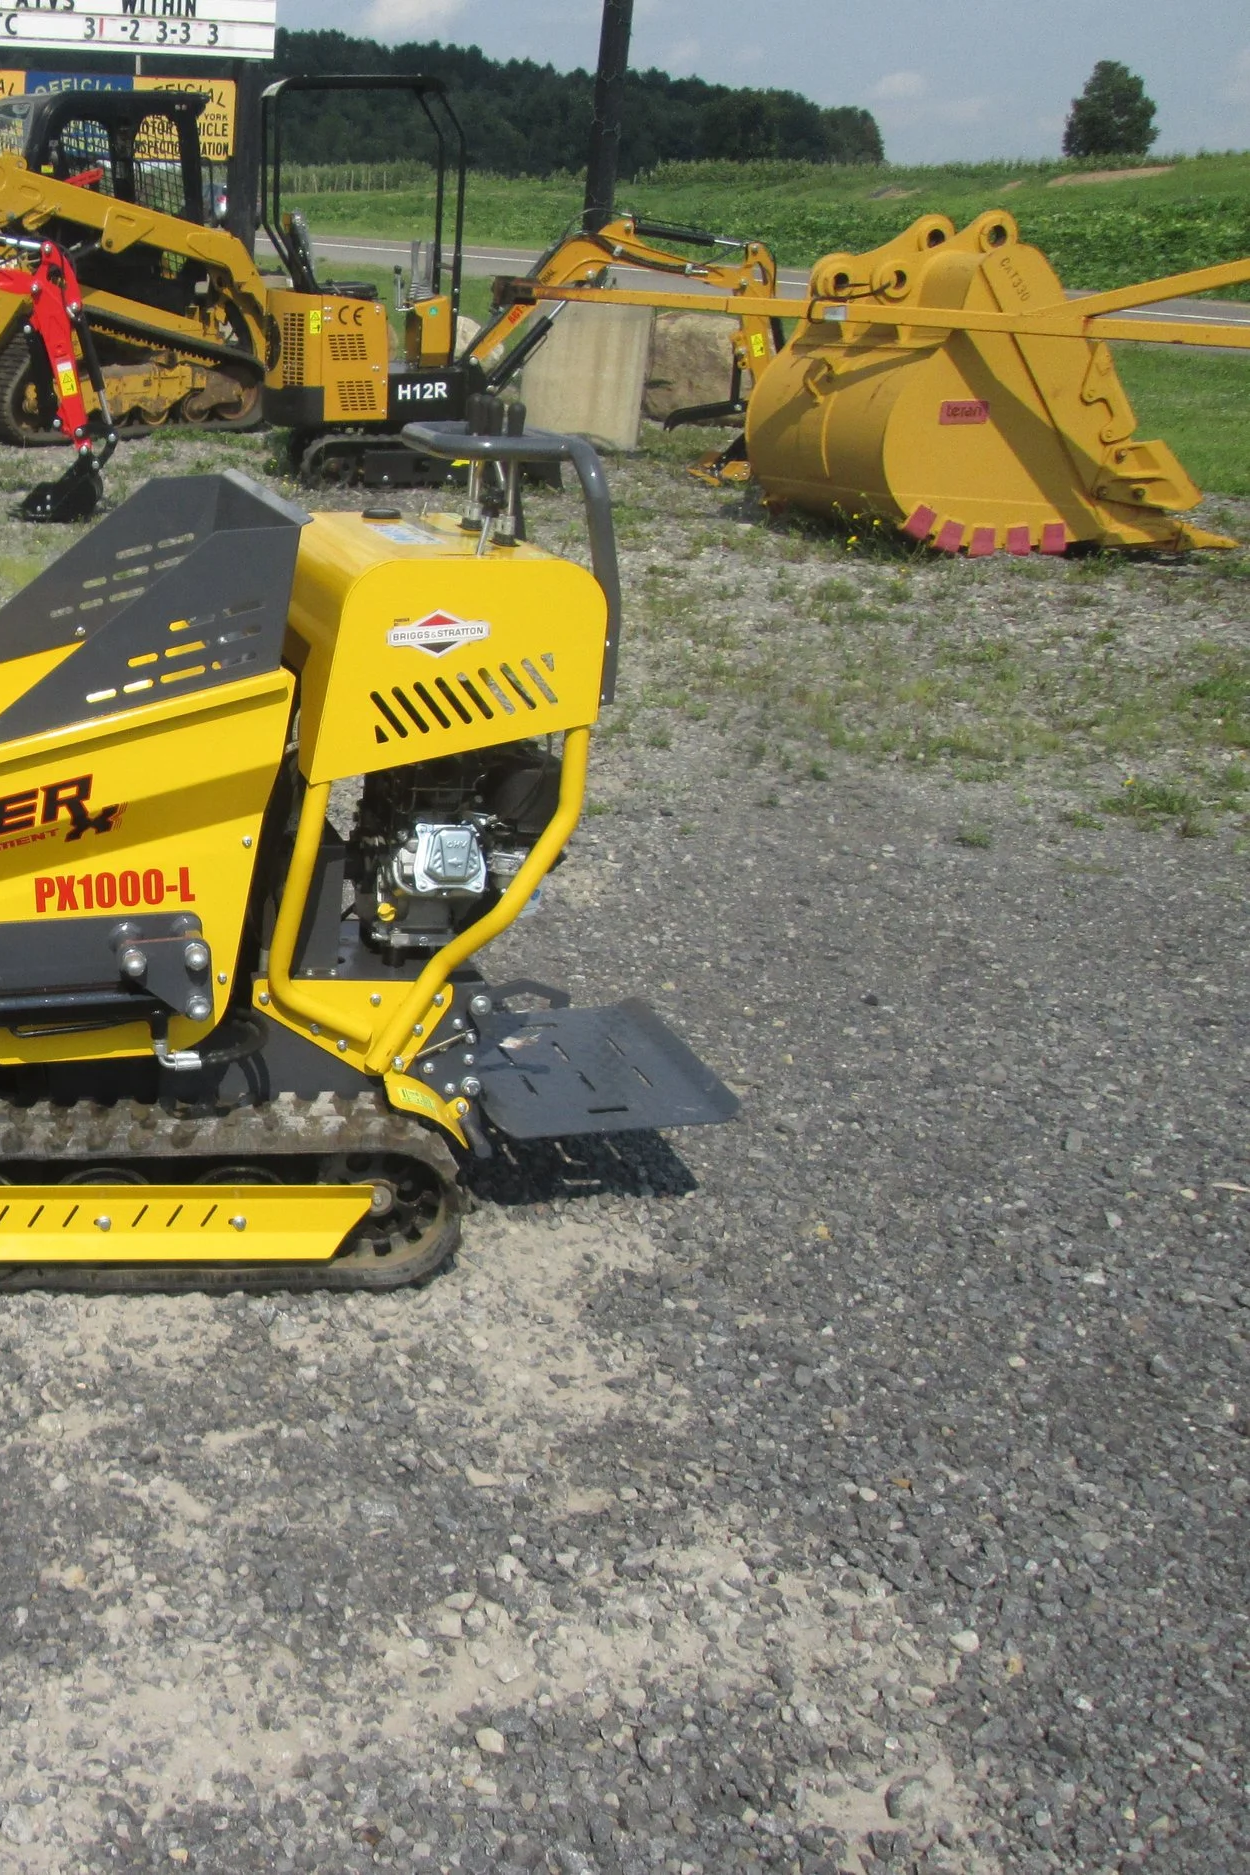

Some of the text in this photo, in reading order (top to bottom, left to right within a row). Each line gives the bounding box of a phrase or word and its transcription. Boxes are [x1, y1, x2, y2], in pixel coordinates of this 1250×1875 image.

[35, 77, 123, 95] OFFICIA
[204, 113, 228, 122] YORK
[397, 381, 448, 401] H12R
[33, 866, 196, 914] PX1000-L
